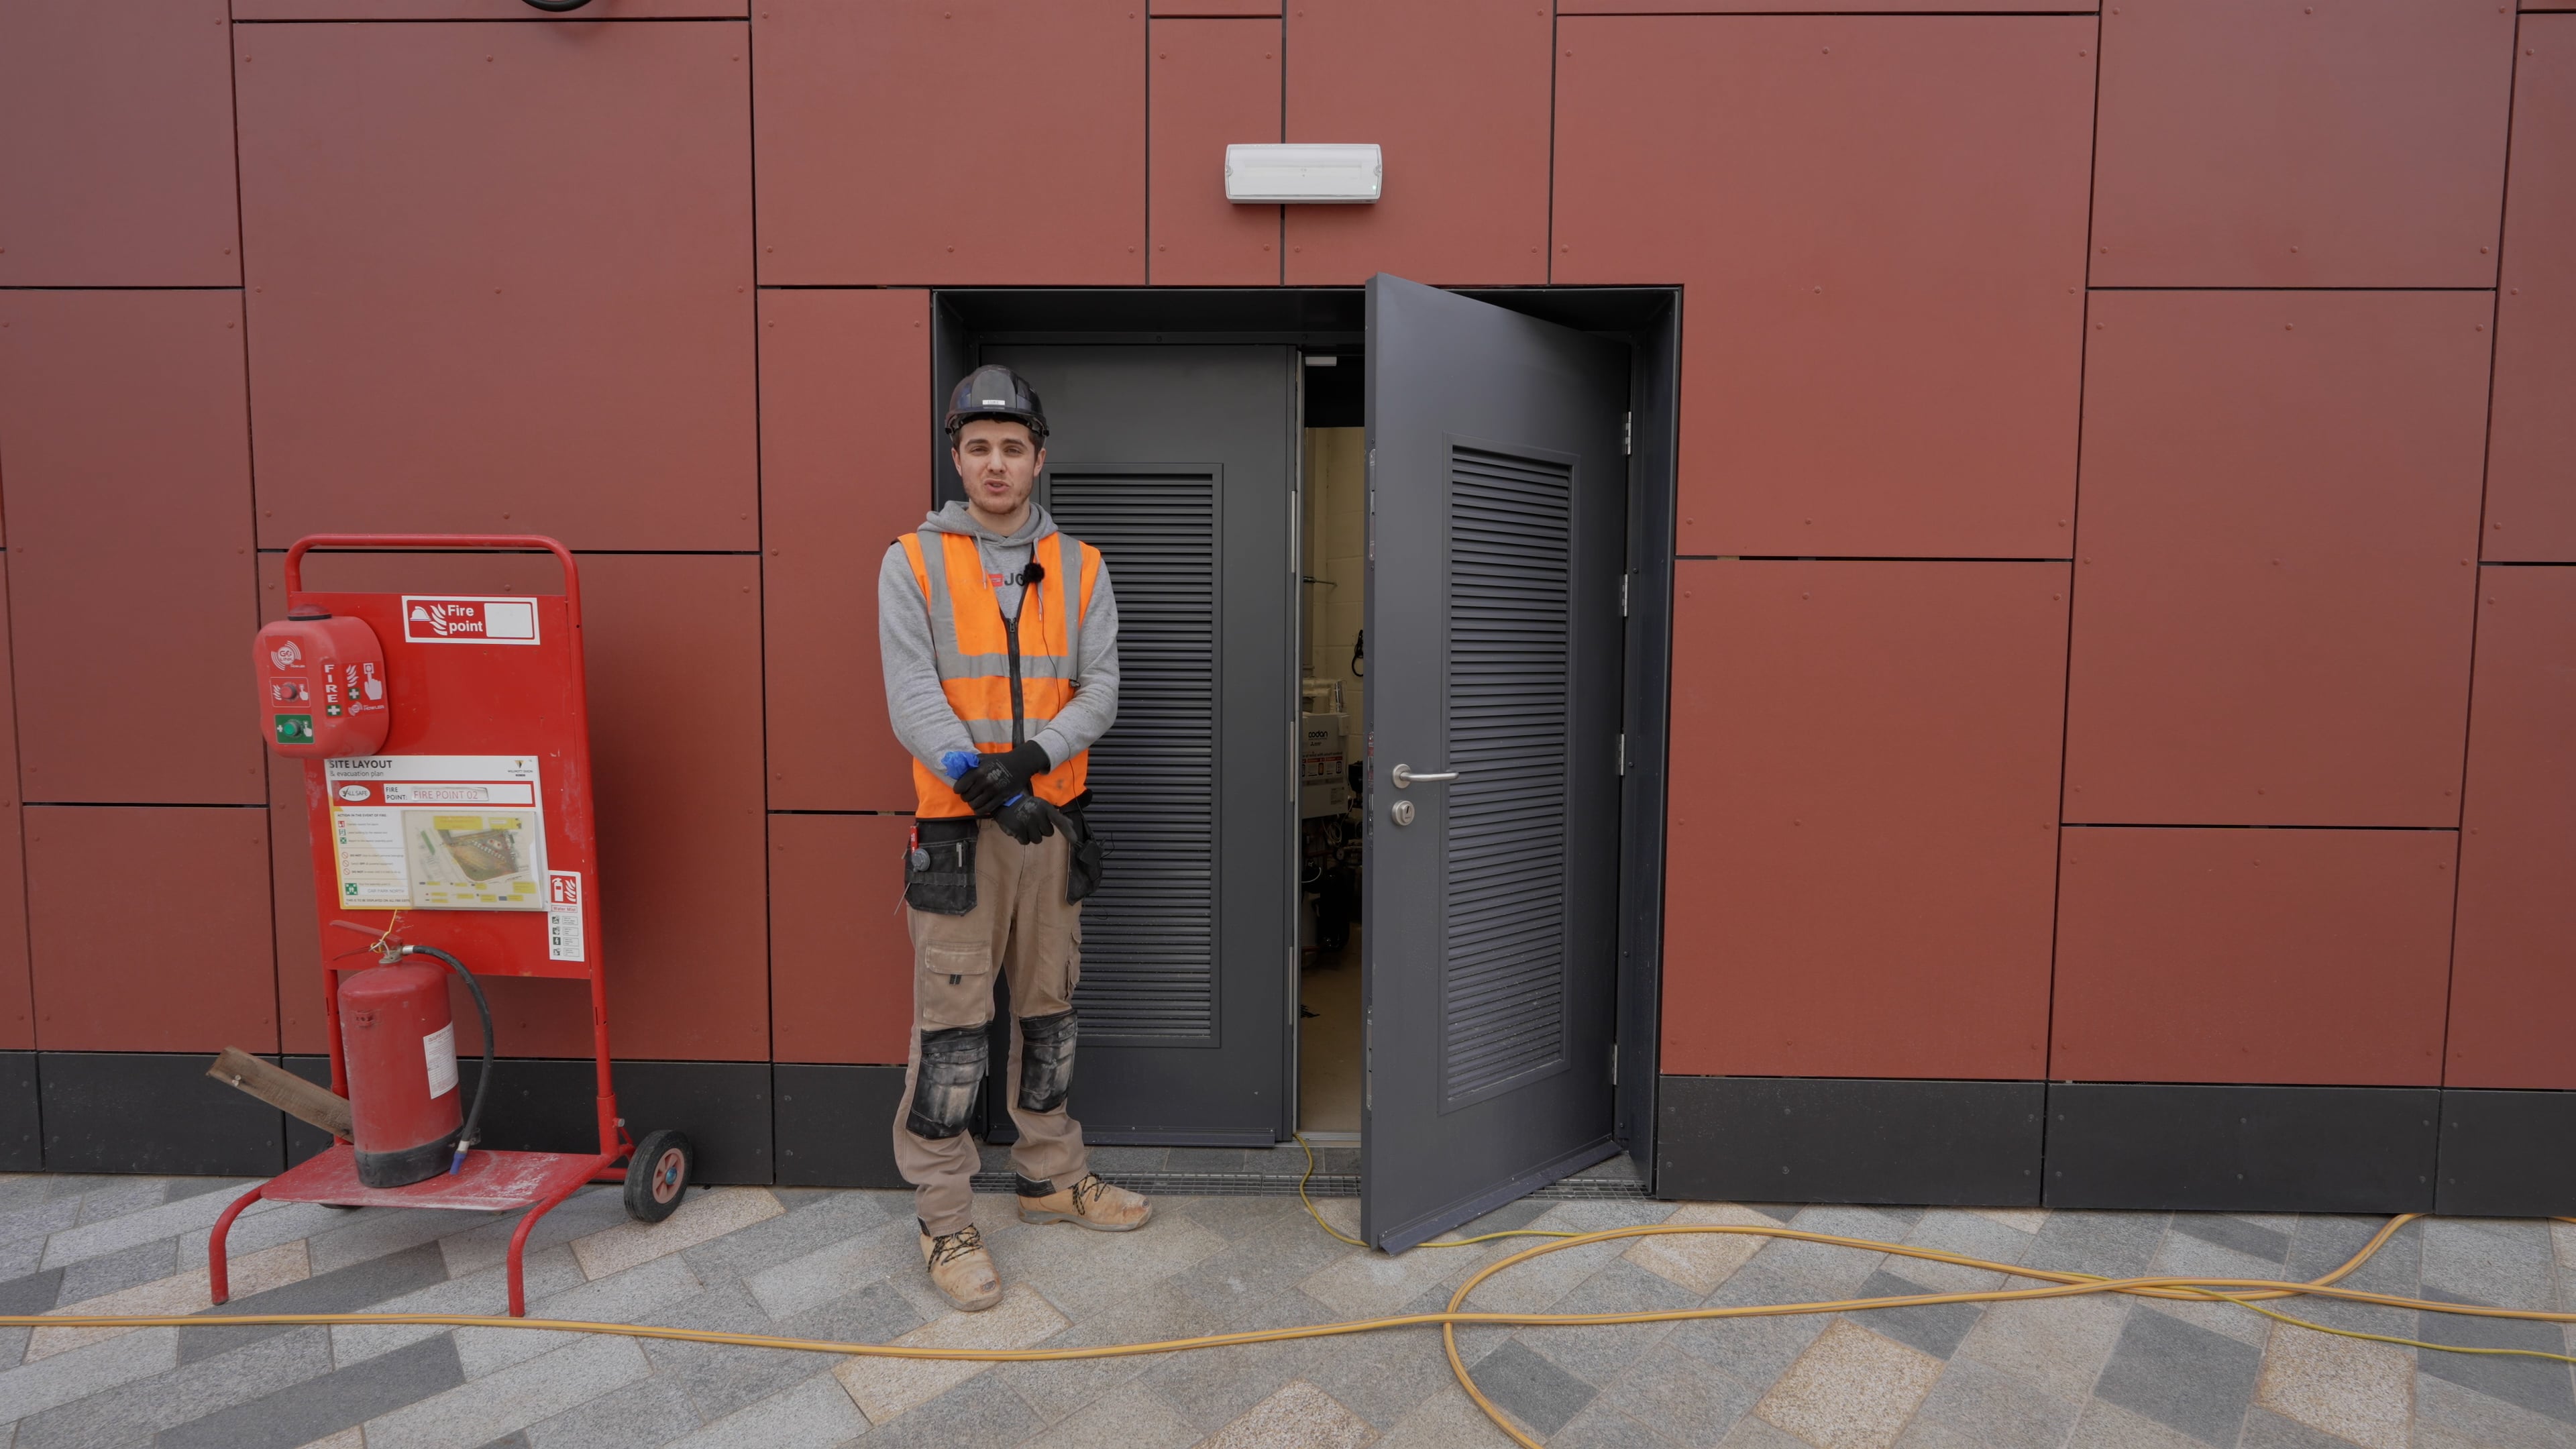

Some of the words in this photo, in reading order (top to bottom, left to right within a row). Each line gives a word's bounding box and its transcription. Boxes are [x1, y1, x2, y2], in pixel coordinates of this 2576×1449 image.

[447, 604, 474, 616] Fire
[449, 621, 483, 634] point
[324, 664, 338, 703] FIRE
[329, 760, 350, 768] SITE
[352, 760, 392, 769] LAYOUT
[413, 790, 433, 800] FIRE
[436, 790, 464, 800] POINT
[466, 790, 478, 800] 02
